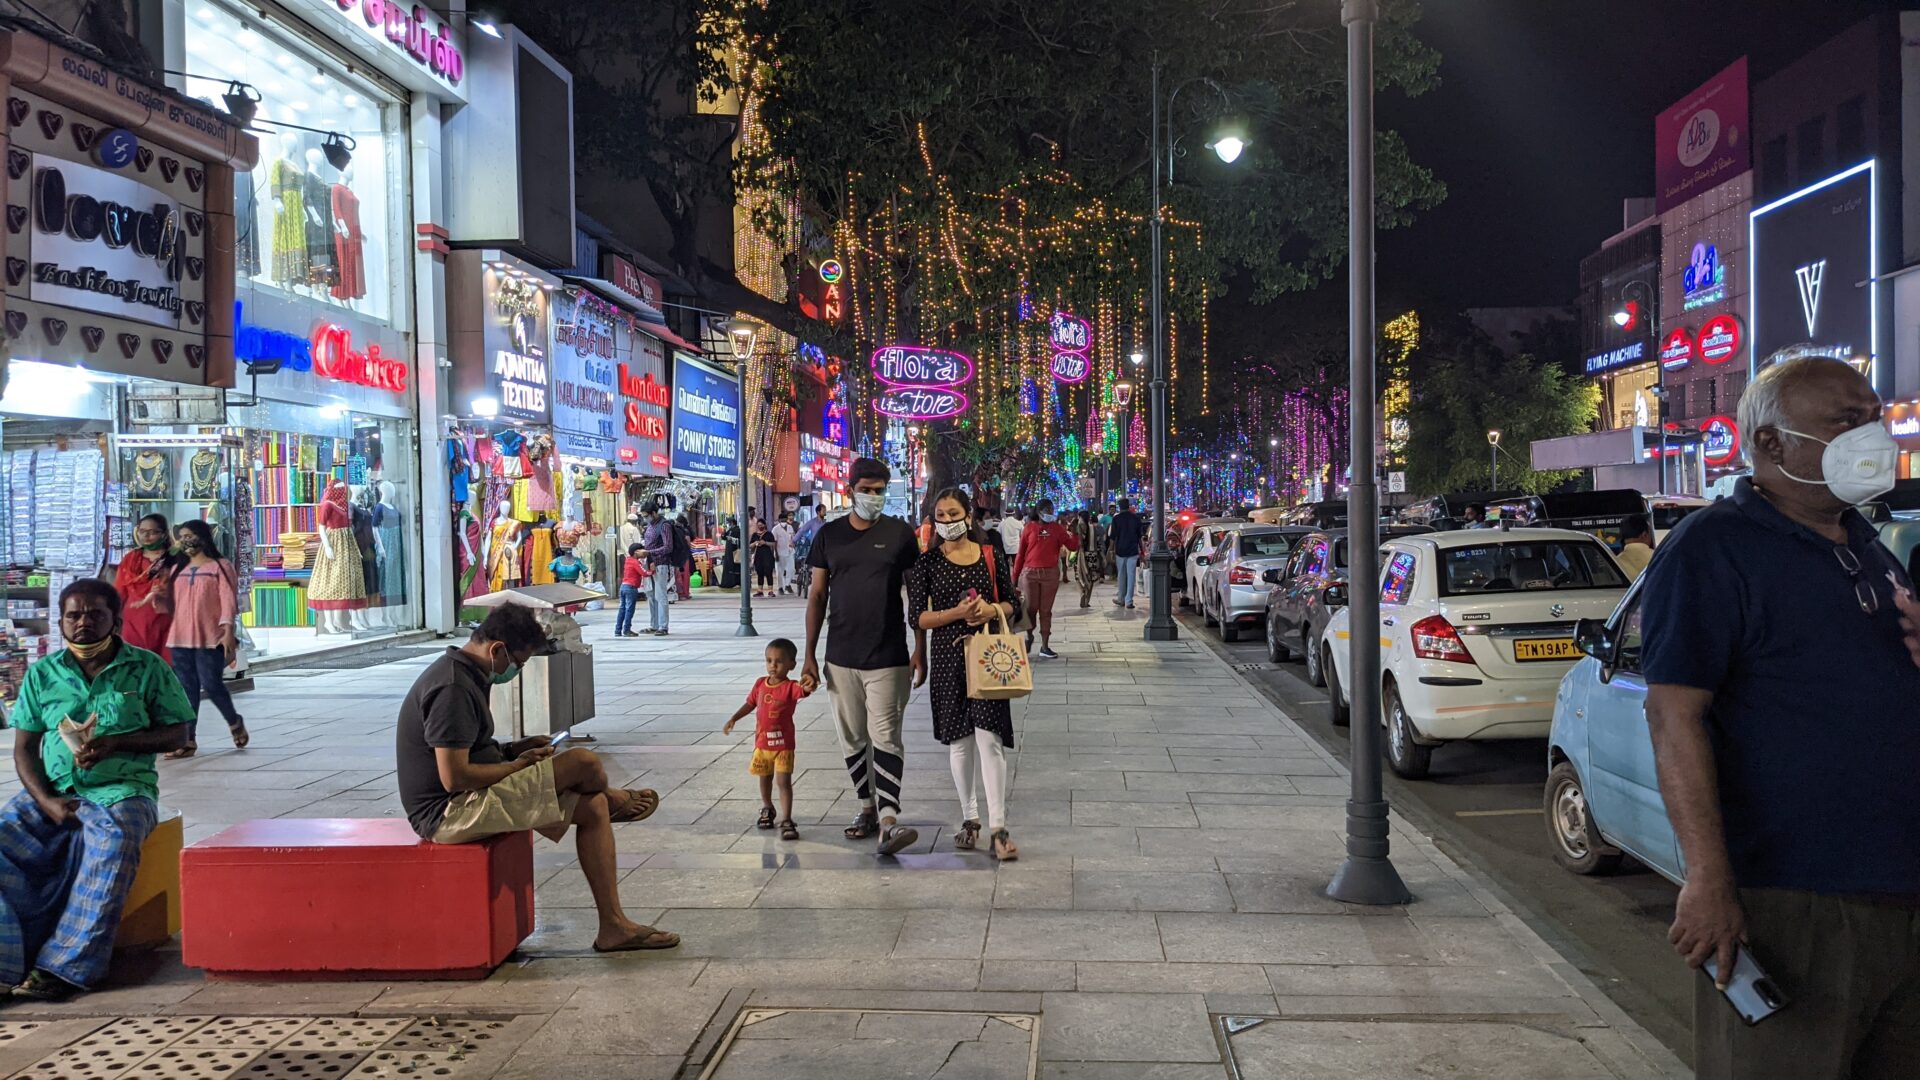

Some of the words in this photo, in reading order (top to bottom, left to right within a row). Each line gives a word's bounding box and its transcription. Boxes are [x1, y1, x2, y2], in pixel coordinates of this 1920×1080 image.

[1609, 342, 1643, 366] MACHINE
[501, 380, 546, 413] TEXTILES
[617, 361, 671, 409] London
[624, 400, 666, 442] Stores
[677, 427, 708, 455] PONNY
[707, 434, 736, 460] STORES
